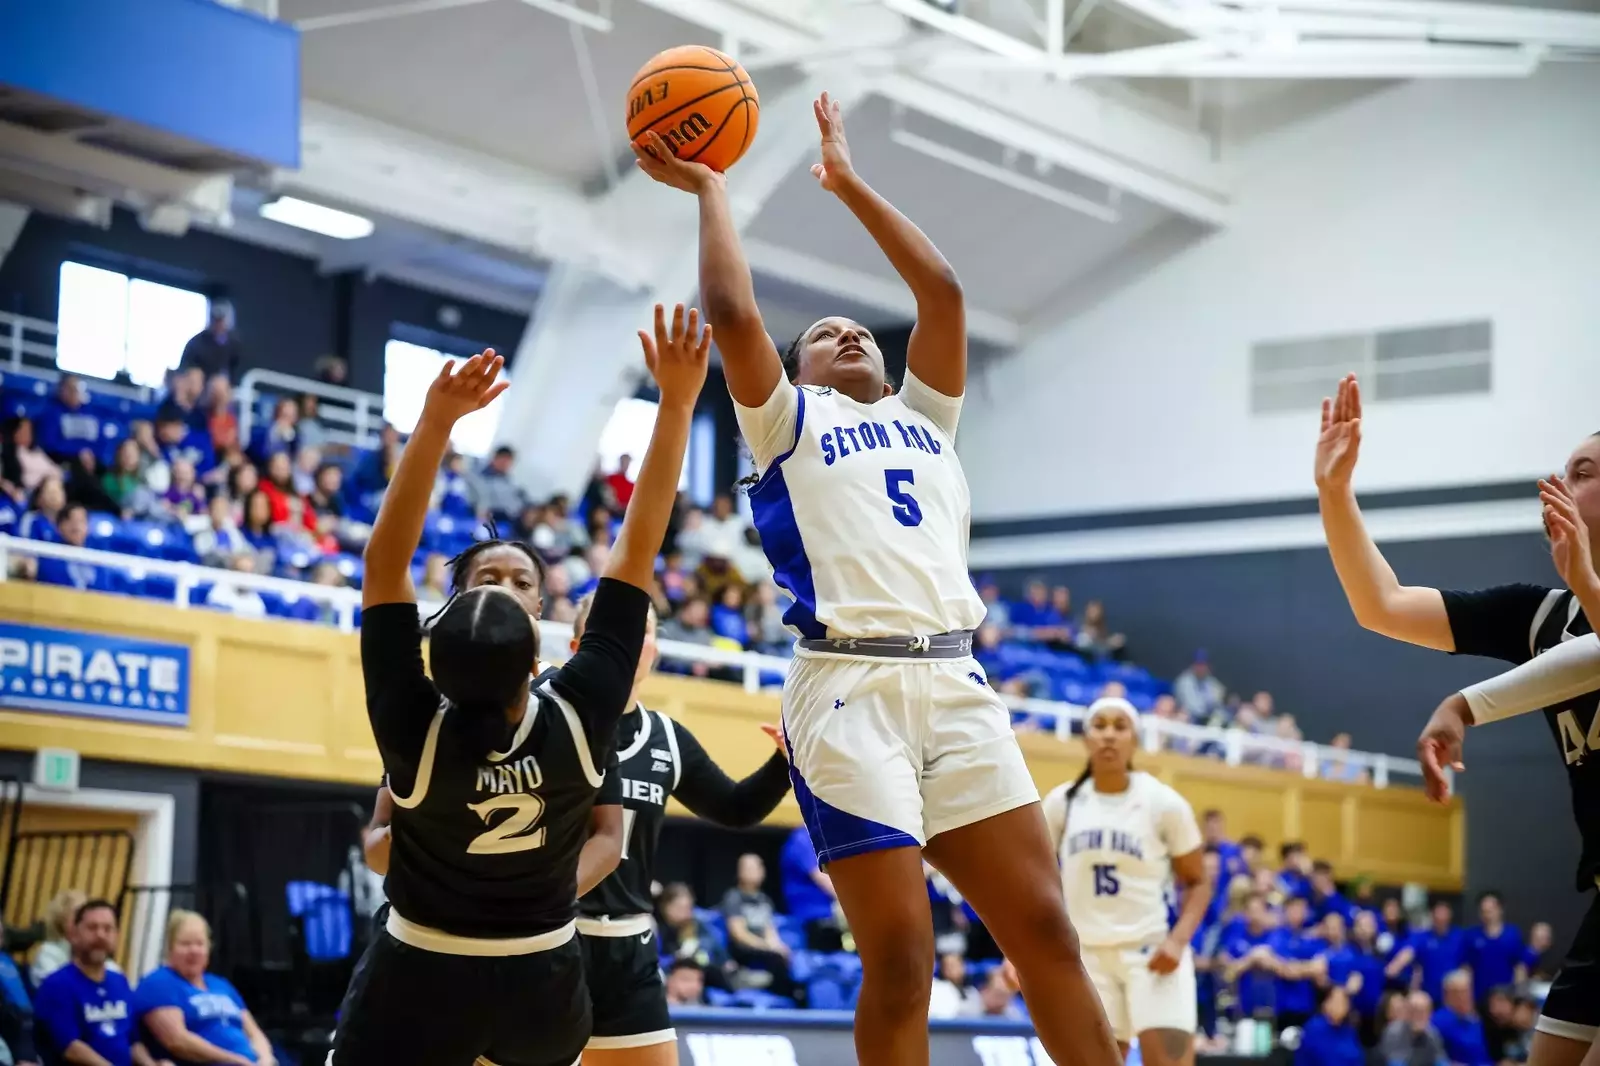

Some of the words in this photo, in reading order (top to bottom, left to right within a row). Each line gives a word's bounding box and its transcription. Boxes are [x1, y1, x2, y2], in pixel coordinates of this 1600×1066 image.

[820, 421, 892, 466] SETON
[892, 420, 941, 454] HAL
[884, 469, 923, 526] 5
[0, 637, 180, 693] PIRATE
[476, 755, 543, 793] MAYO
[466, 792, 547, 854] 2
[1092, 864, 1120, 895] 15
